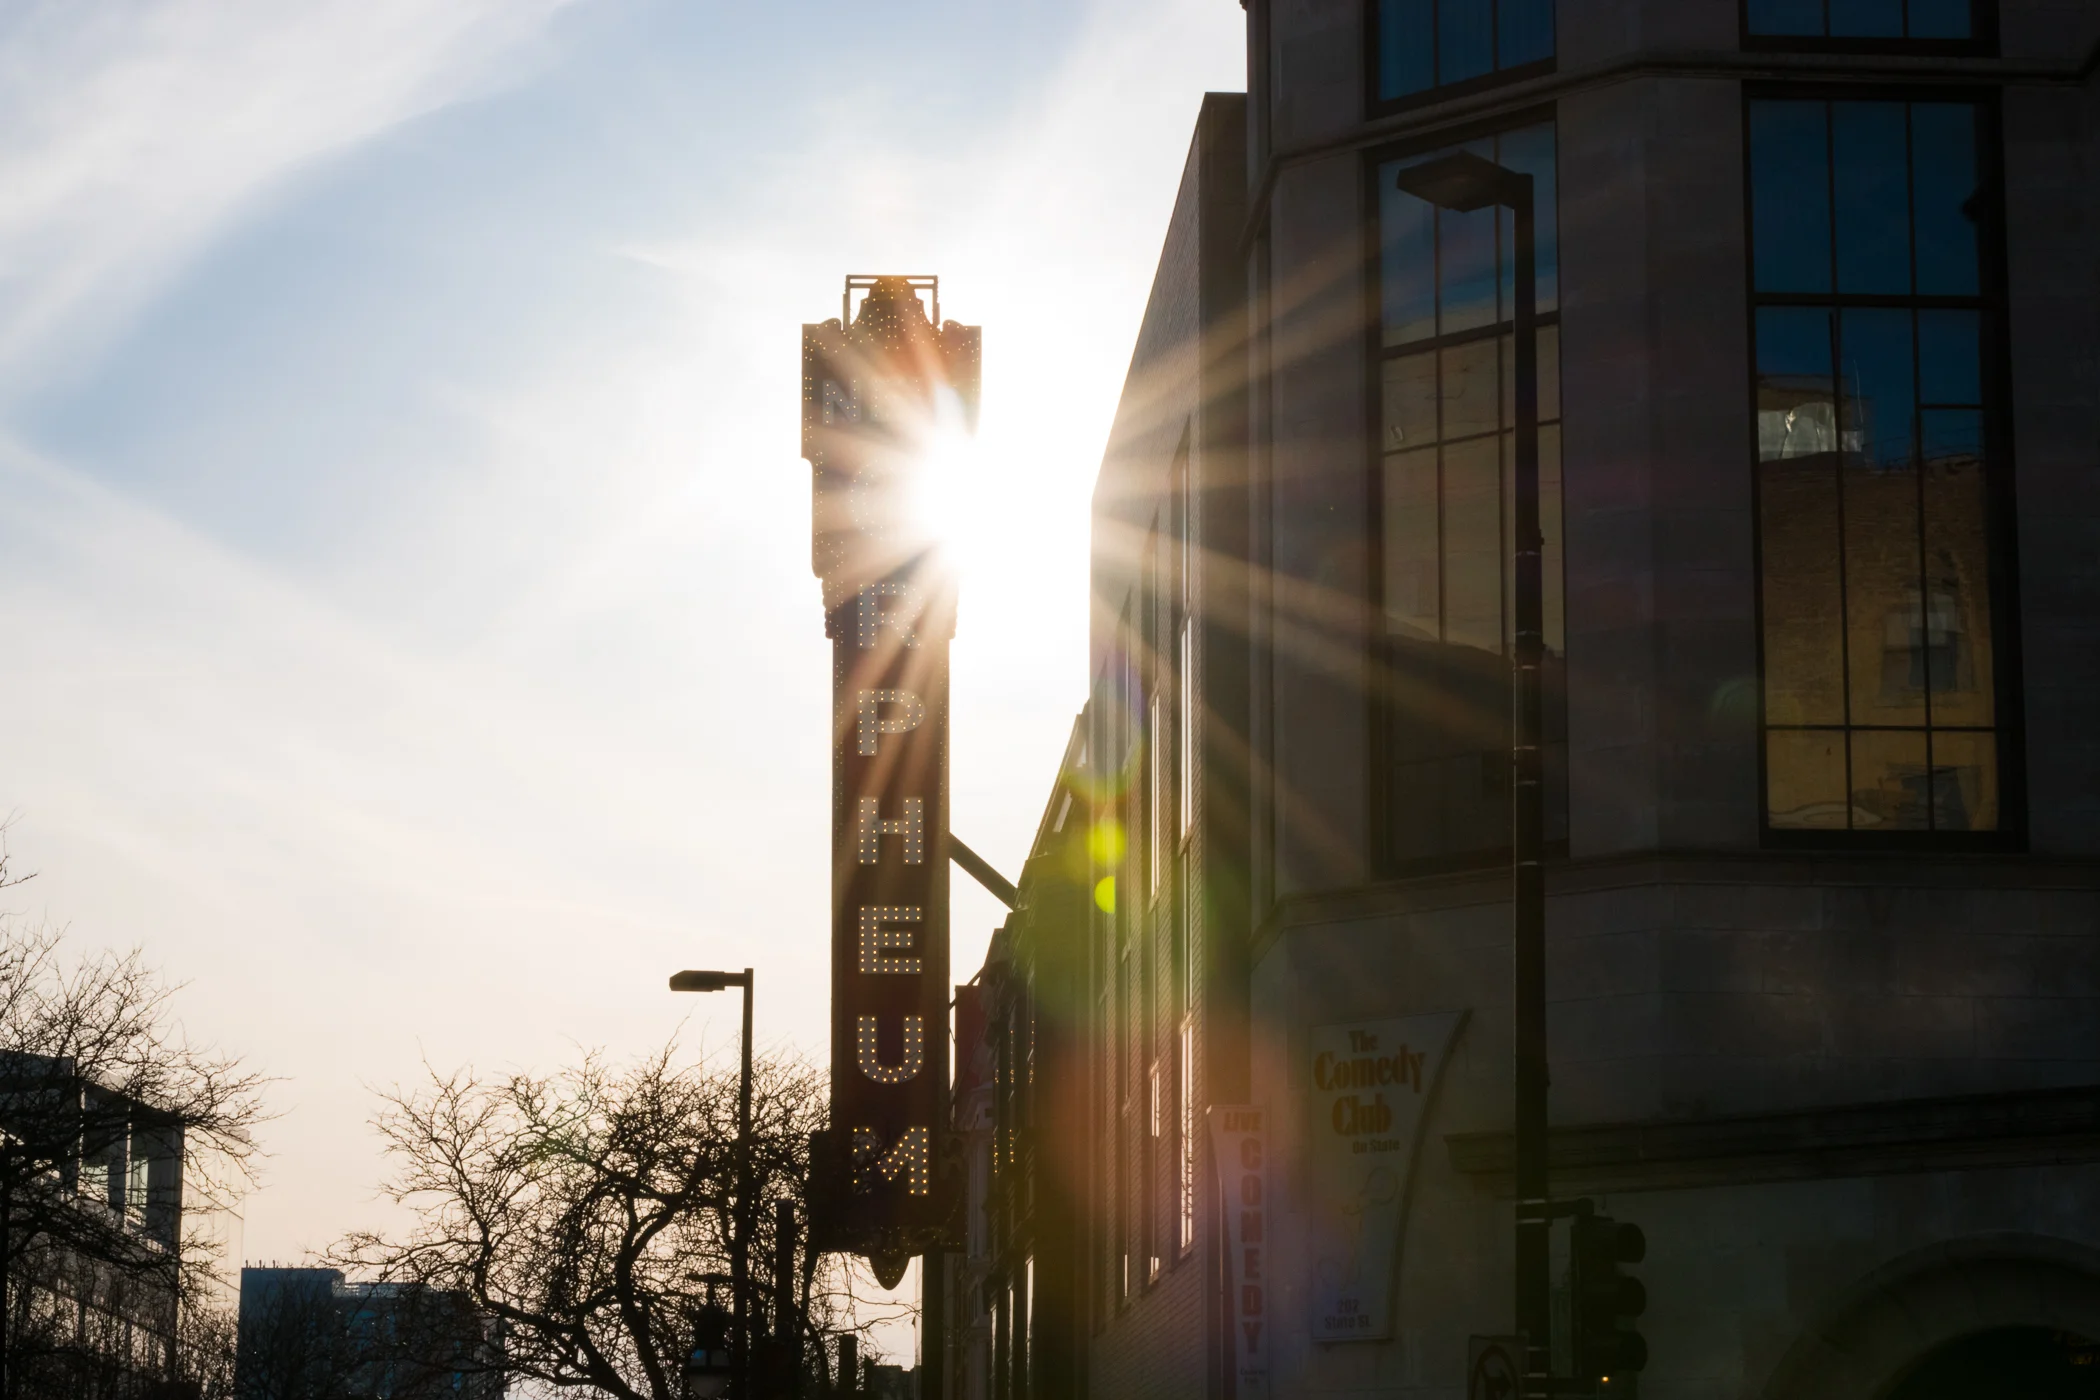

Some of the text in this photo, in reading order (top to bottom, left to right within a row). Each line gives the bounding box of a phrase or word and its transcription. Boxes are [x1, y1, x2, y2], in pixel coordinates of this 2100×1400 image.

[1348, 1029, 1378, 1054] The
[1314, 1043, 1426, 1094] Comedy
[1223, 1111, 1262, 1133] LIVE
[1332, 1092, 1392, 1137] Club
[1369, 1138, 1400, 1153] State
[1240, 1137, 1263, 1354] COMEDY
